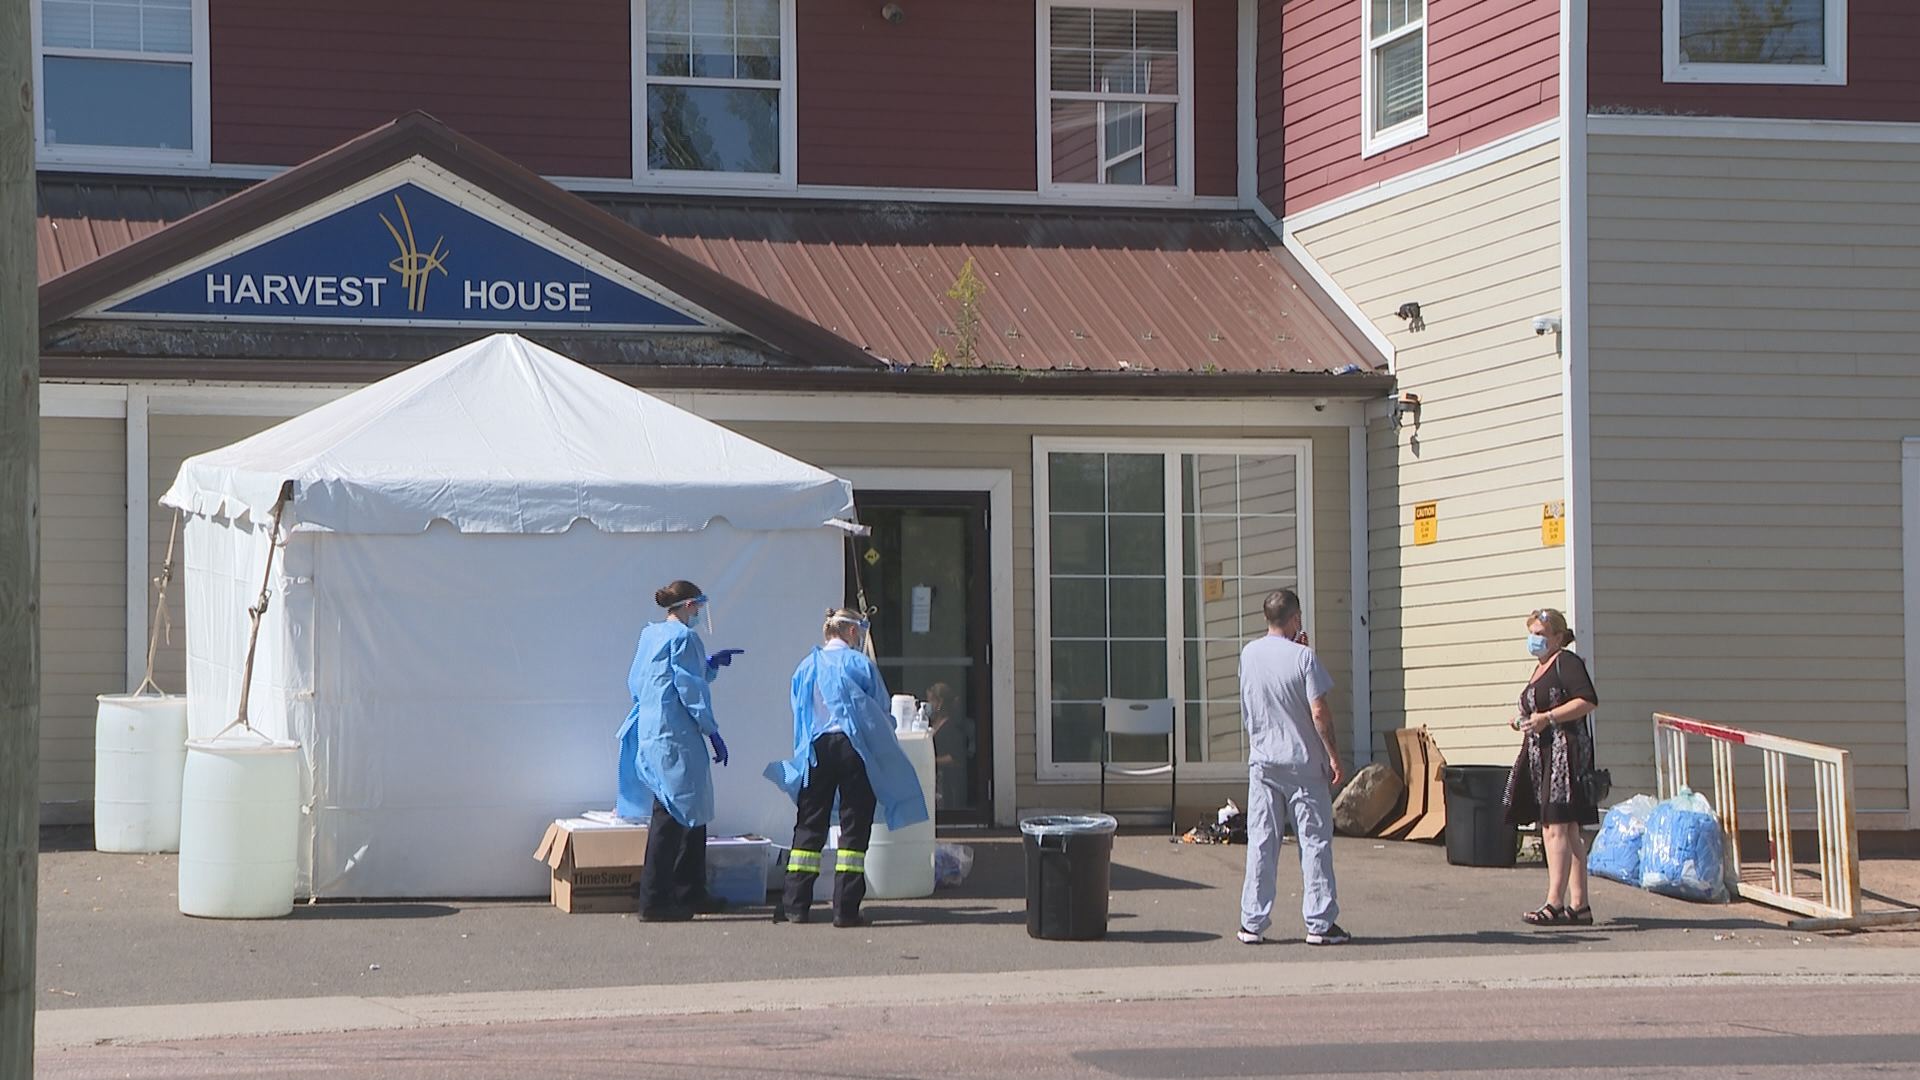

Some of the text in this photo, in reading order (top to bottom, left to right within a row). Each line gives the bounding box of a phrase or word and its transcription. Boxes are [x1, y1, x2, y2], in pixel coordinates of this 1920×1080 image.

[205, 273, 592, 312] HARVEST HOUSE
[1416, 506, 1435, 518] CAUTION
[574, 871, 632, 886] TimeSaver
